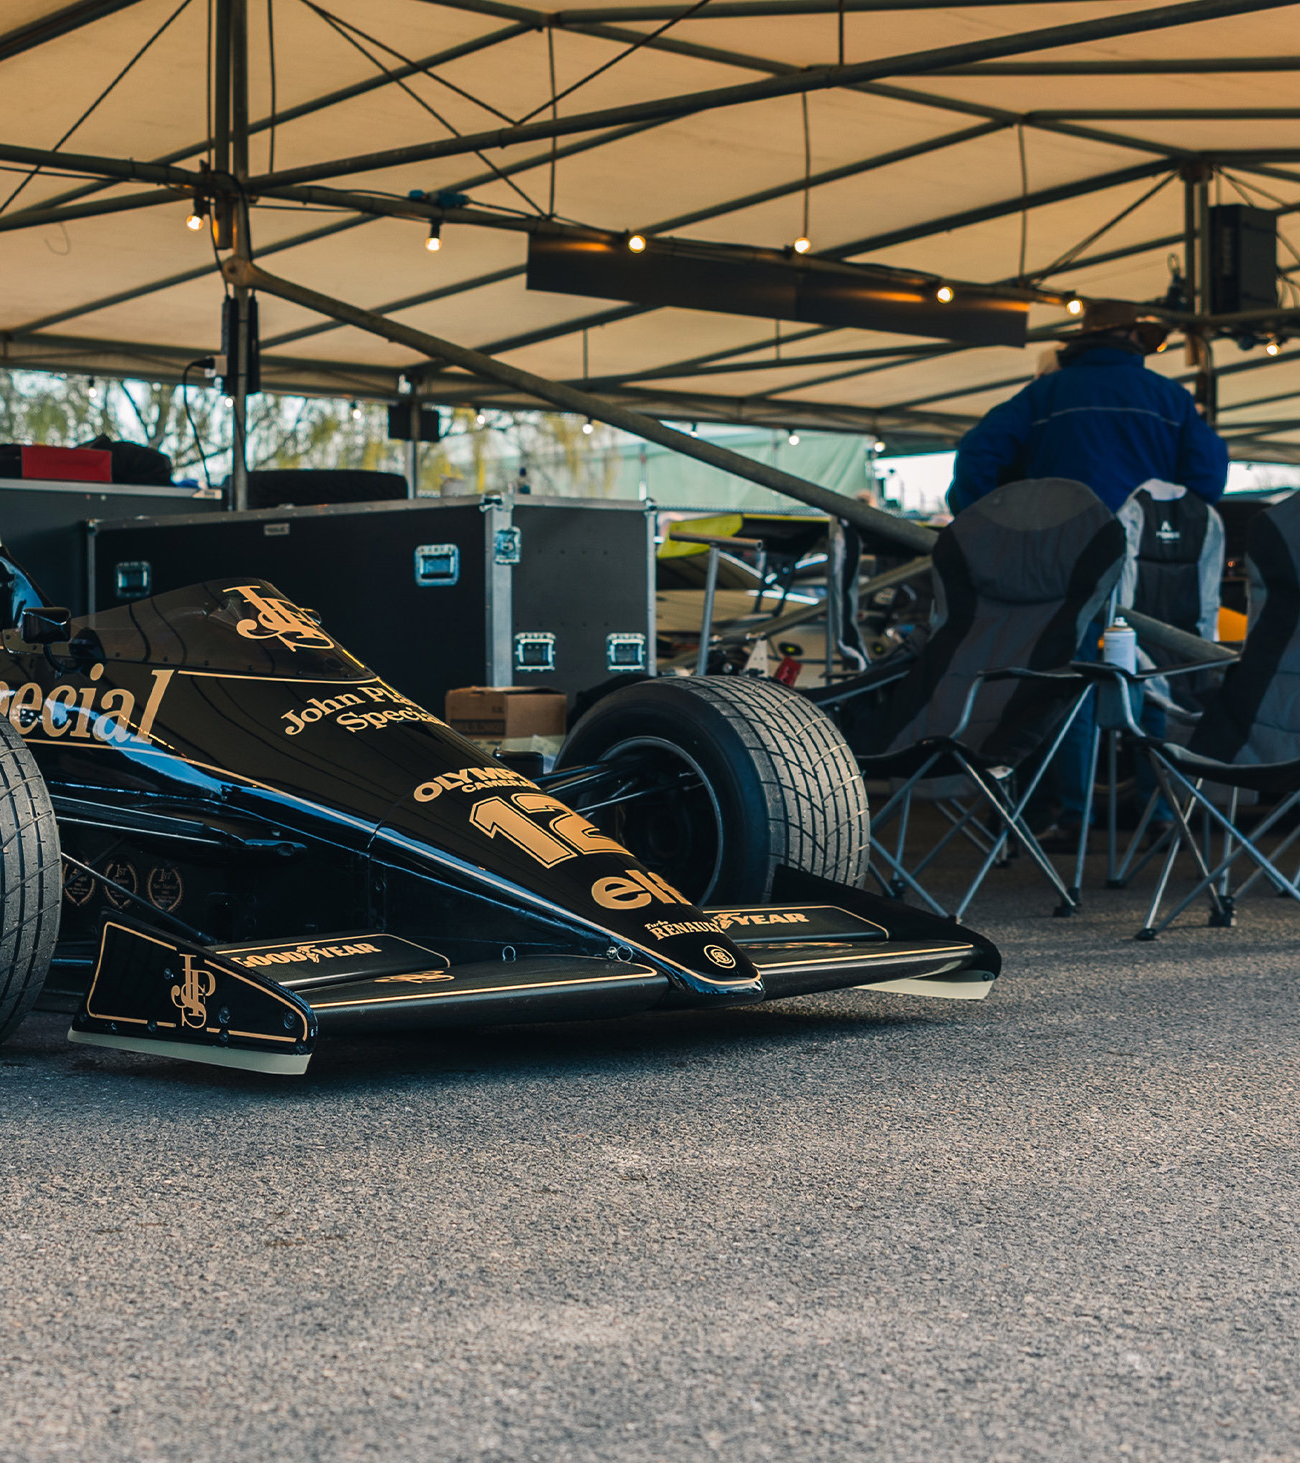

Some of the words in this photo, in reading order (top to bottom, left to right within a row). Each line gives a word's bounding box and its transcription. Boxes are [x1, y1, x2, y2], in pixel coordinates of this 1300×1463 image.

[280, 692, 366, 736] John
[469, 792, 636, 869] 12
[230, 943, 382, 968] GOODYEAR
